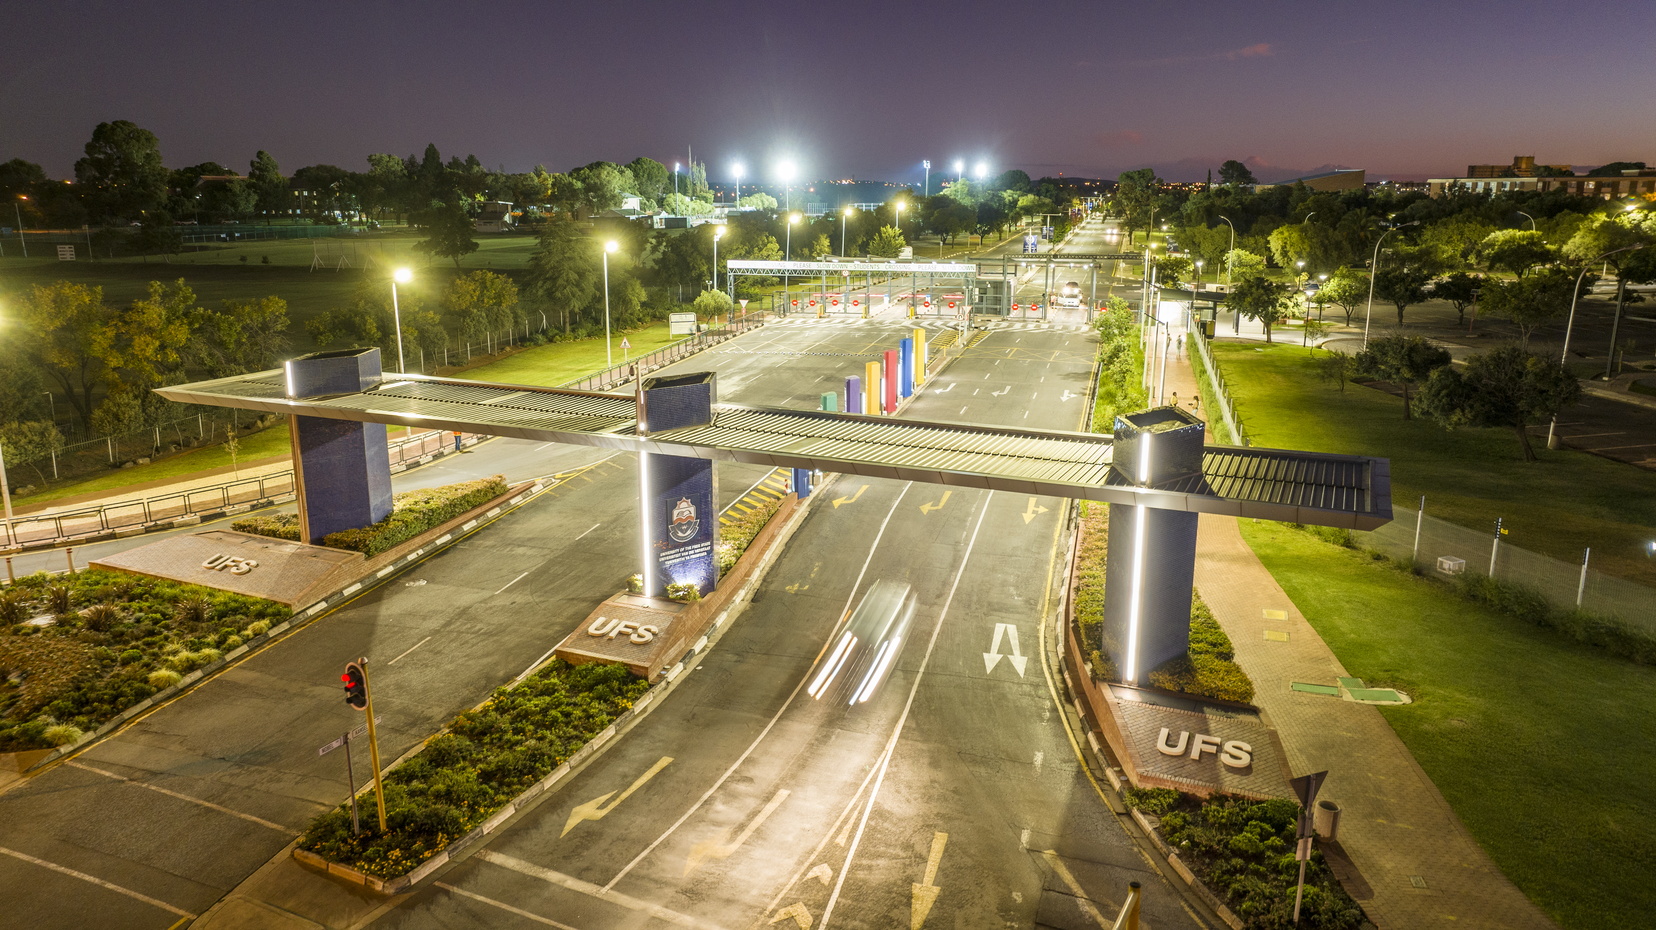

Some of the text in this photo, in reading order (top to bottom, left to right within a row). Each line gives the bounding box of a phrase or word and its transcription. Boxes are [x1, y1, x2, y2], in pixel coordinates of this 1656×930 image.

[201, 553, 258, 575] UFS
[588, 616, 659, 645] UFS
[1156, 727, 1252, 768] UFS
